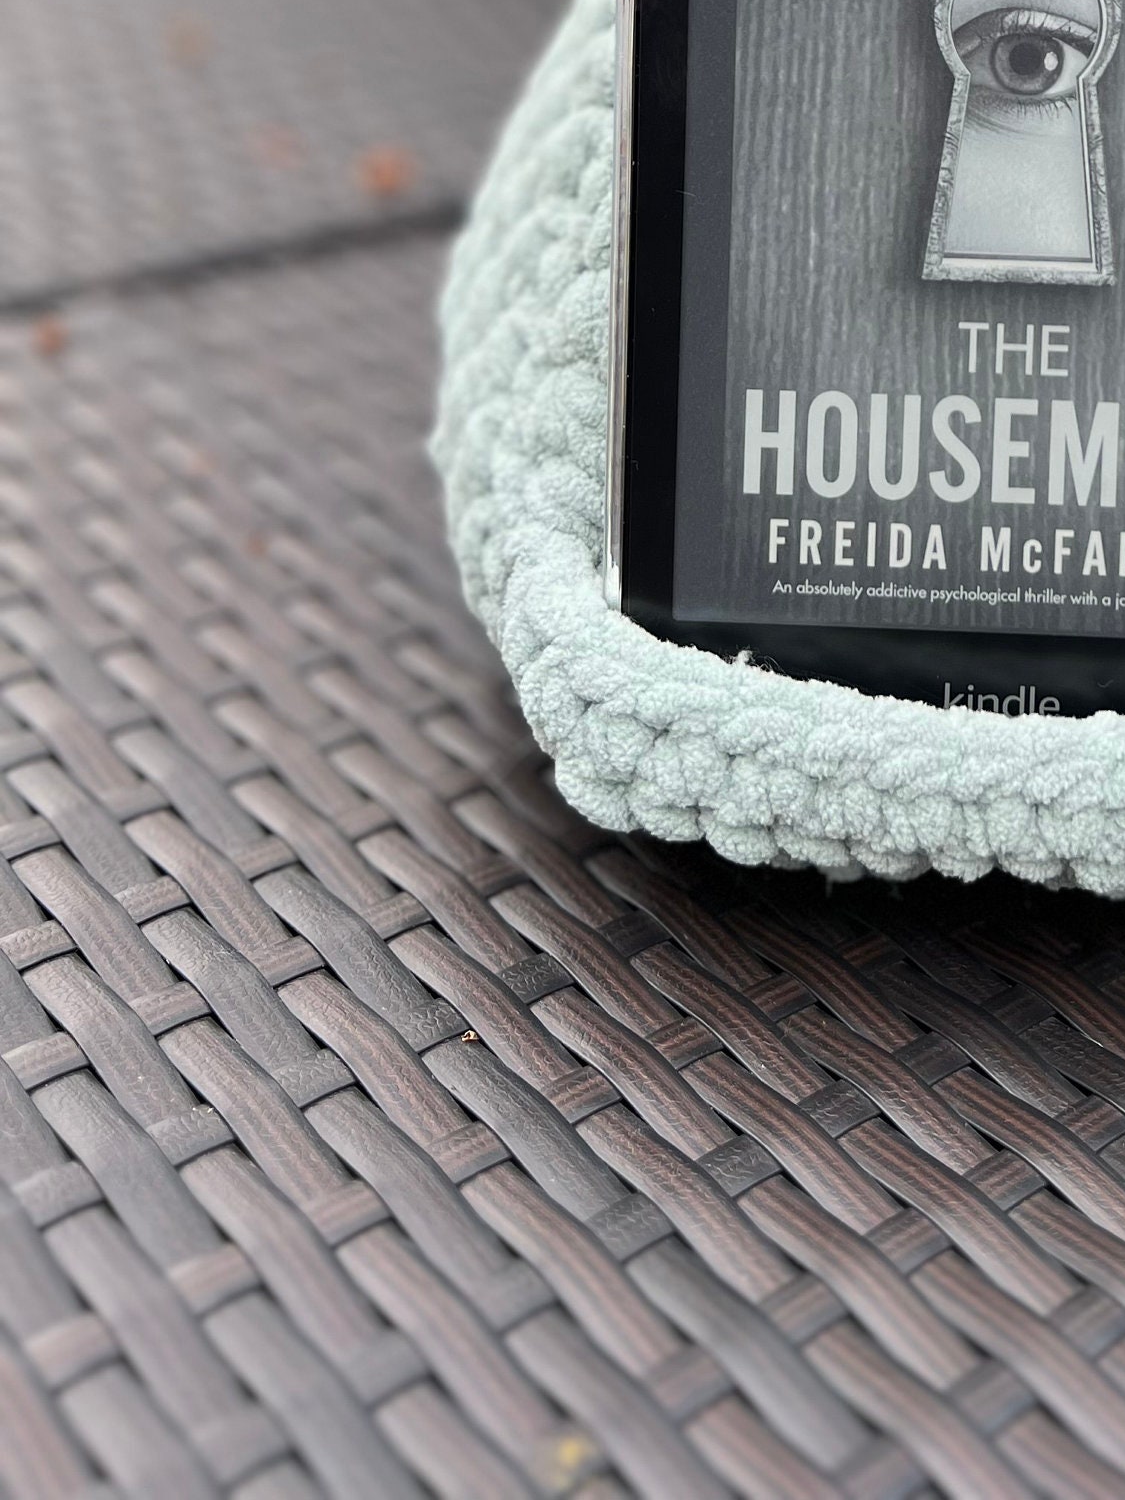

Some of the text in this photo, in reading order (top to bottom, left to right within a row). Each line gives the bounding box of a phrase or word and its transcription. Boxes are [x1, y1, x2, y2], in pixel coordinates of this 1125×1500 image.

[958, 321, 1071, 377] THE
[768, 518, 948, 571] FREIDA
[772, 579, 792, 594] An
[796, 579, 863, 600] absolutely
[867, 582, 927, 599] addictive
[930, 585, 1020, 605] psychological
[1025, 588, 1067, 604] thriller
[1070, 590, 1098, 606] with
[1102, 597, 1111, 607] a
[943, 682, 1061, 719] kindle
